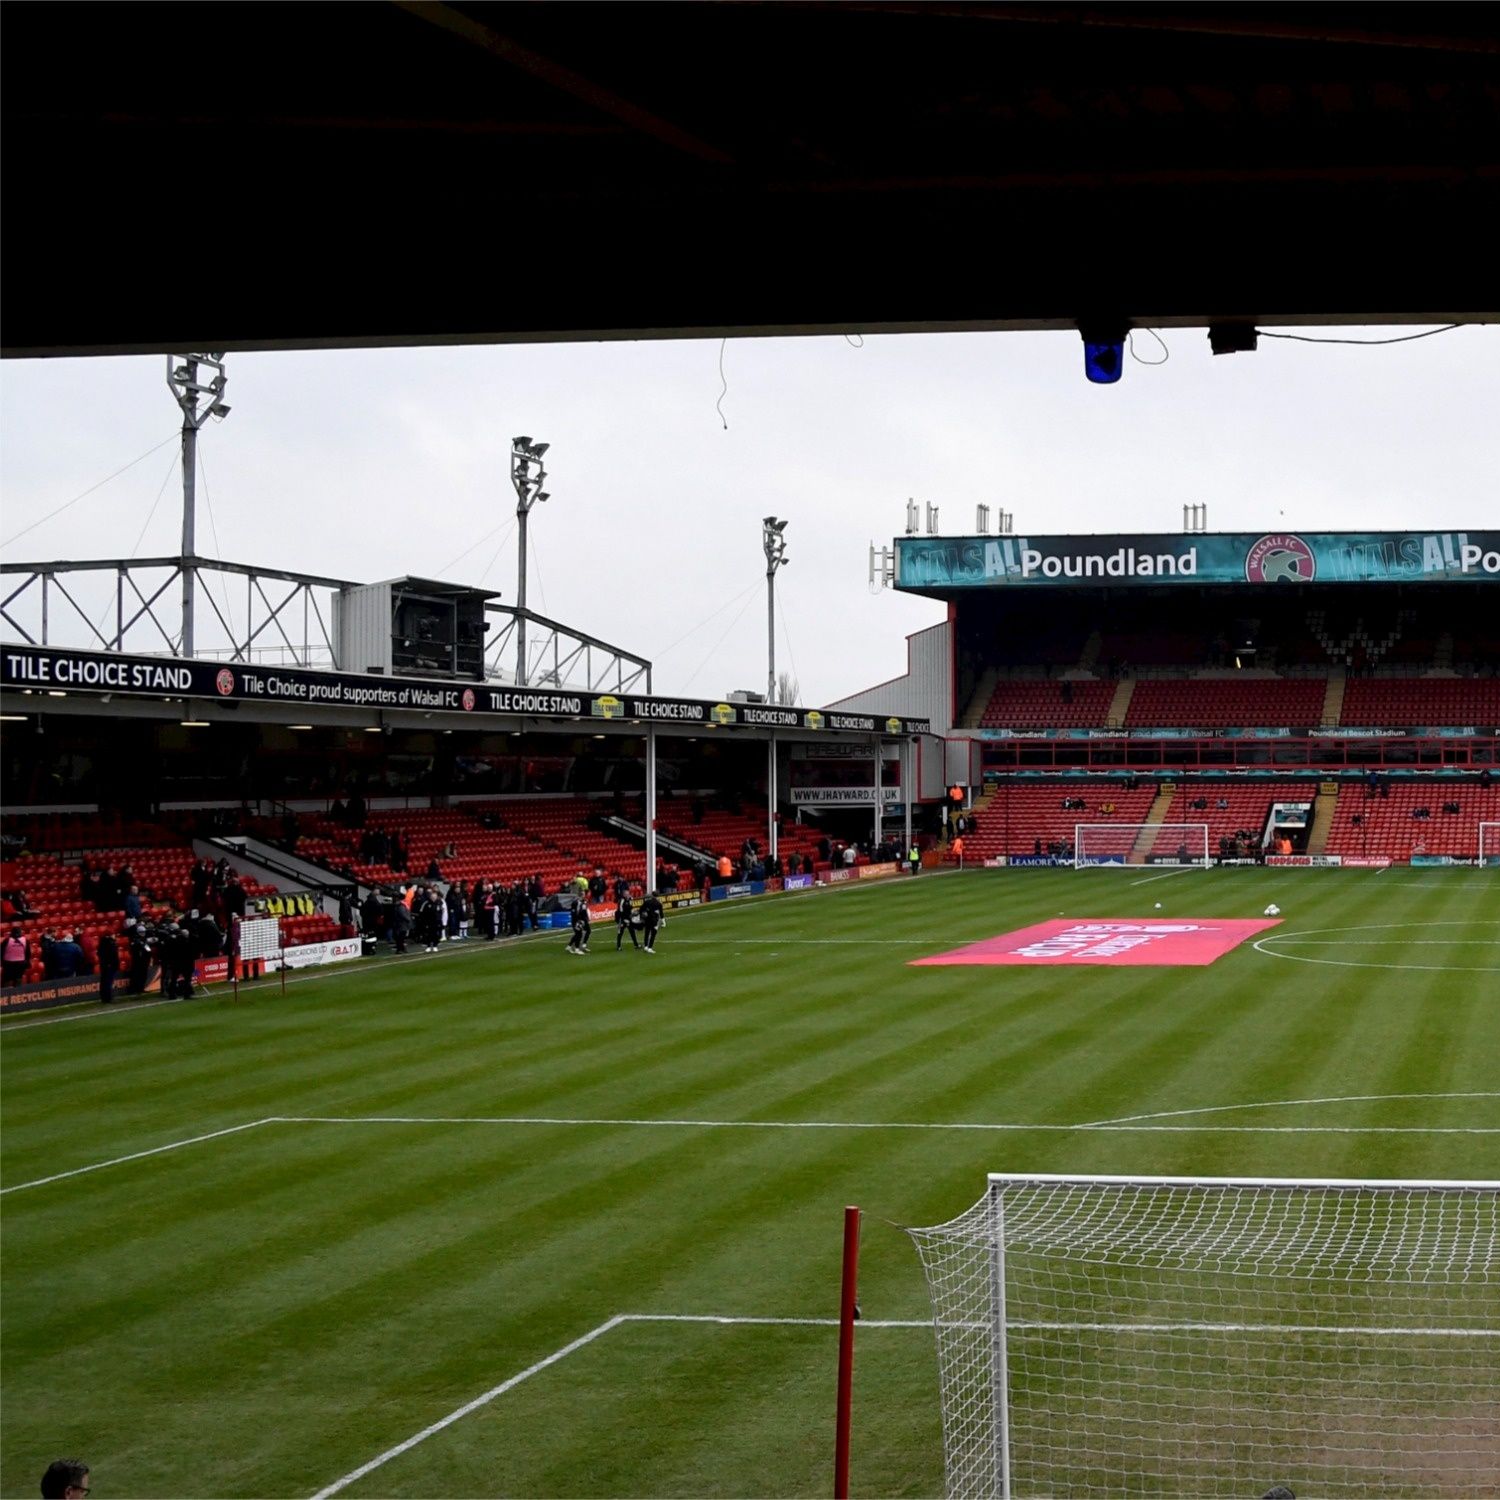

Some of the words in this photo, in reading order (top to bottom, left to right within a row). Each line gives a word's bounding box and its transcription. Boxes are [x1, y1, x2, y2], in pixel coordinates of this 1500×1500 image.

[1022, 547, 1197, 578] Poundland
[1249, 537, 1282, 569] WALSALL
[1285, 538, 1298, 549] FC
[7, 655, 50, 682] TILE
[55, 660, 128, 687] CHOICE
[133, 666, 192, 691] STAND
[242, 674, 264, 693] Tile
[267, 677, 306, 698] Choice
[309, 683, 341, 700] proud
[344, 687, 397, 704] supporters
[398, 688, 410, 704] of
[411, 689, 444, 706] Walsall
[446, 691, 459, 707] FC
[490, 693, 511, 711] TILE
[512, 695, 549, 712] CHOICE
[550, 696, 581, 714] STAND
[634, 701, 650, 717] TILE
[650, 703, 679, 719] CHOICE
[679, 705, 703, 720] STAND
[743, 709, 756, 723] TILE
[756, 710, 777, 724] CHOICE
[778, 712, 798, 726] STAND
[830, 715, 841, 728] TILE
[841, 716, 858, 729] CHOICE
[858, 718, 874, 730] STAND
[794, 790, 897, 800] WWW.JHAYWARD.C.UK
[1010, 857, 1052, 867] LEAMORE
[10, 988, 56, 1005] RECYCLING
